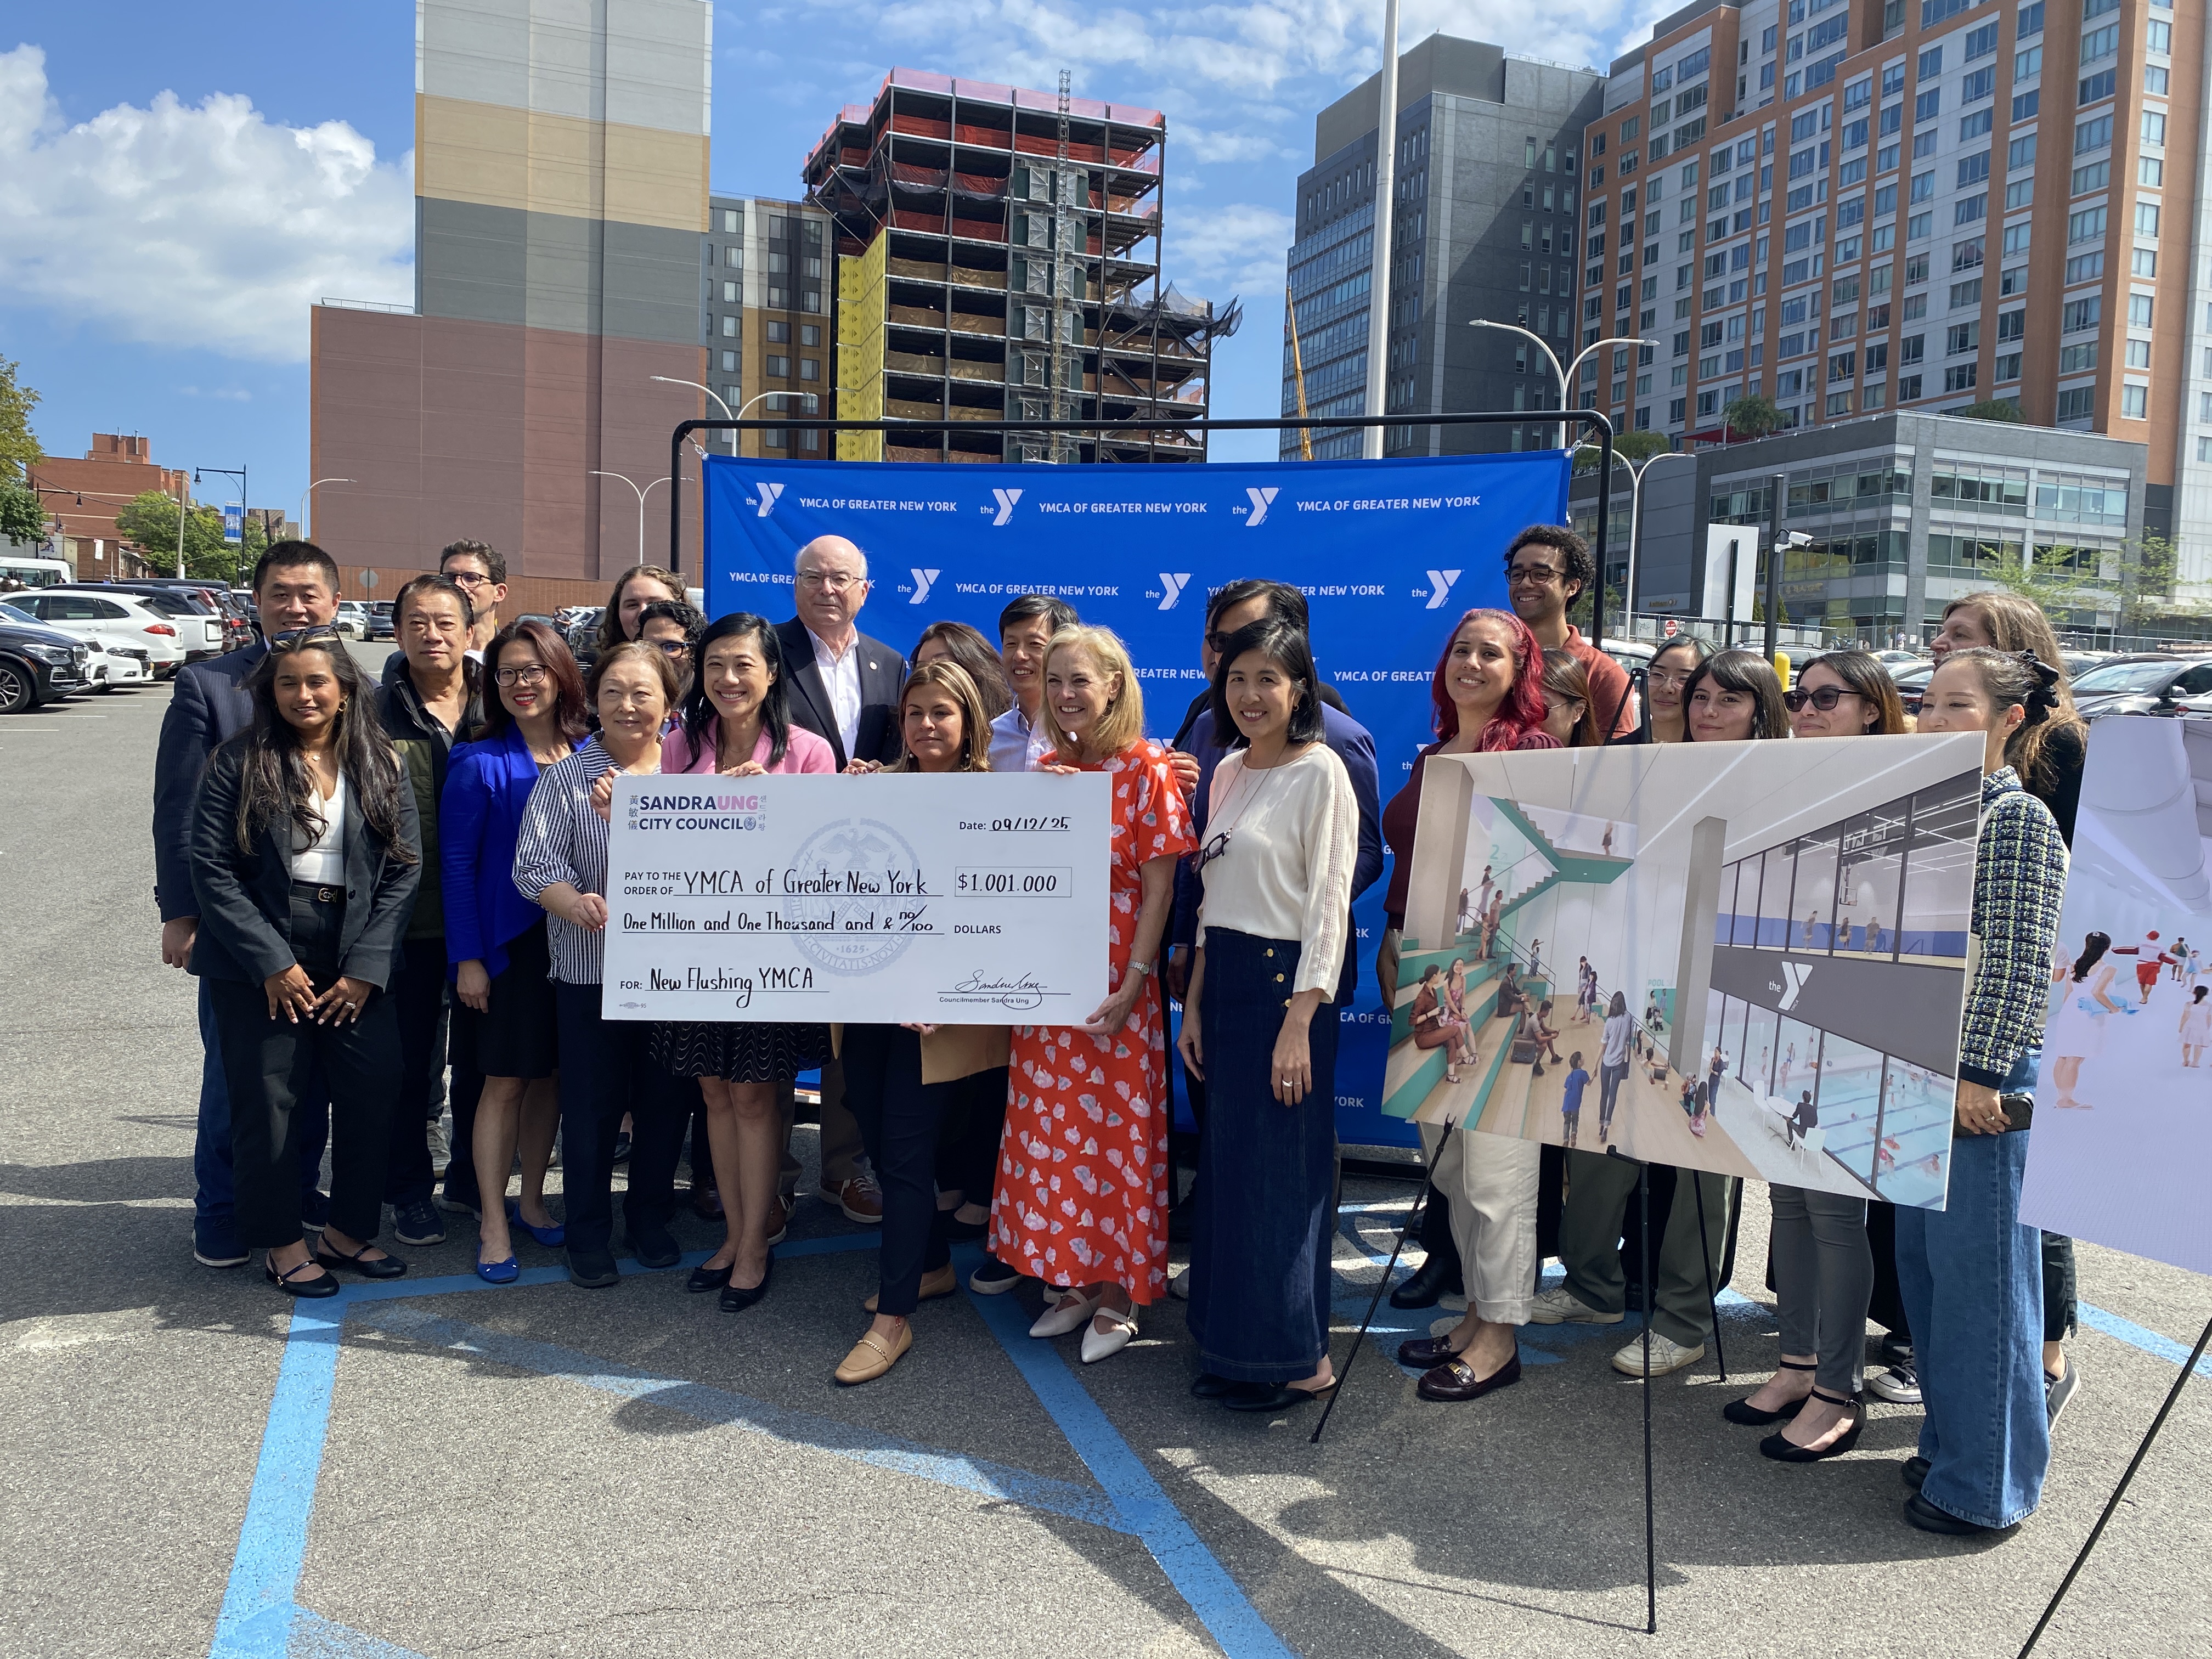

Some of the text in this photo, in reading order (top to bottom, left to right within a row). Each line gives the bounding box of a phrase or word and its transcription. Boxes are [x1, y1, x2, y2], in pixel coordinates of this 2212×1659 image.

[746, 497, 758, 505] the
[799, 498, 957, 511] YMCA OF GREATER NEW YORK
[1296, 495, 1481, 511] YMCA OF GREATER NEW YORK
[980, 505, 994, 514] the
[1039, 503, 1207, 513] YMCA OF GREATER NEW YORK
[1232, 506, 1248, 514] the
[729, 572, 757, 583] YMCA
[759, 573, 770, 583] OF
[898, 584, 911, 592] the
[955, 583, 1119, 596] YMCA OF GREATER NEW YORK
[1319, 585, 1347, 596] NEW
[1350, 585, 1385, 595] YORK
[1412, 588, 1427, 597] the
[1146, 590, 1160, 598] the
[1133, 668, 1206, 679] REATER NEW
[1334, 671, 1436, 681] YMCA OF GREAT
[1402, 761, 1413, 770] th
[639, 819, 743, 830] CITY COUNCIL
[960, 821, 986, 830] Date:
[1490, 844, 1499, 860] 2
[624, 872, 681, 881] PAY TO THE
[684, 868, 929, 894] YMCA of Greater New York
[624, 887, 674, 895] ORDER OF
[624, 912, 647, 930] One
[651, 911, 695, 930] Million
[704, 910, 731, 931] and
[738, 912, 761, 931] One
[766, 911, 835, 930] Thousand
[845, 911, 874, 930] and
[883, 917, 894, 930] &
[954, 925, 1002, 934] DOLLARS
[620, 980, 643, 990] FOR:
[650, 967, 814, 1008] New Flushing YMCA
[1769, 980, 1781, 992] the
[1170, 1002, 1183, 1012] NE
[1340, 1012, 1356, 1023] CA
[1359, 1013, 1375, 1023] OF
